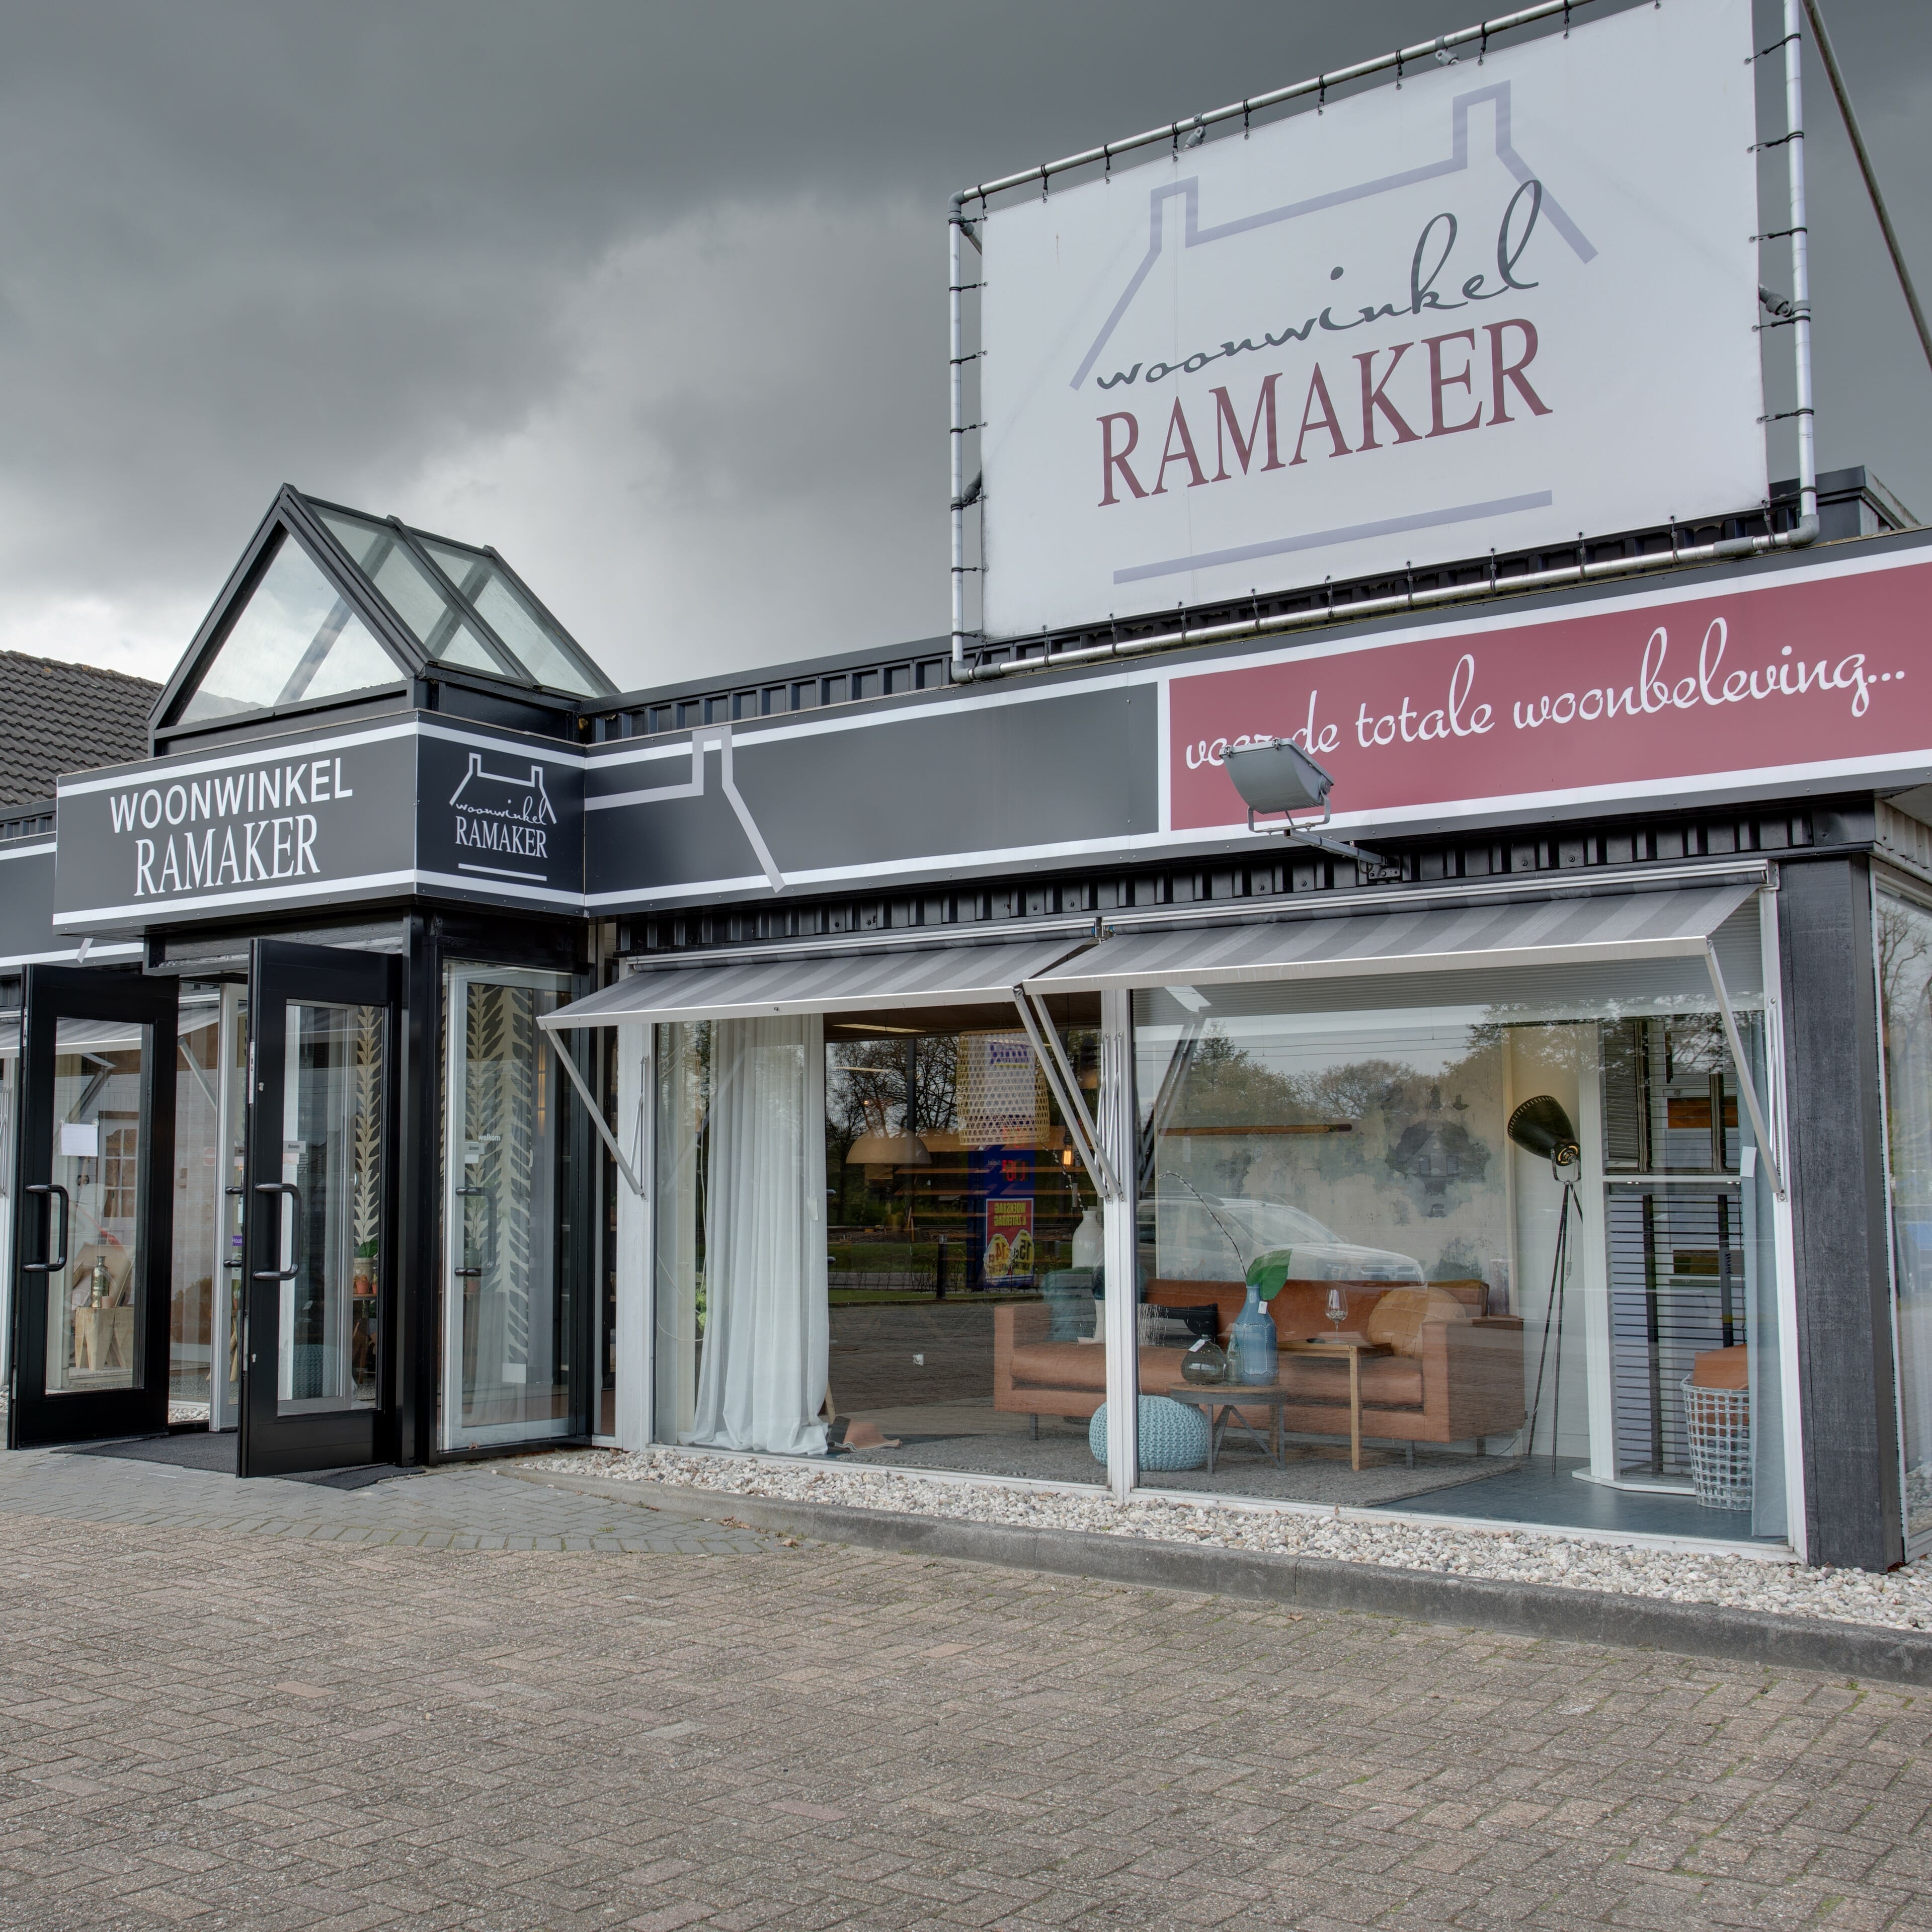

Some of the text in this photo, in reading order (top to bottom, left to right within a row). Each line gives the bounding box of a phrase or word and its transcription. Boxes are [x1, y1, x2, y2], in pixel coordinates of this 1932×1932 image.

[1096, 180, 1543, 390] woonwinkel
[1096, 317, 1553, 507] RAMAKER
[1292, 690, 1340, 755] de
[1355, 654, 1495, 748] totale
[110, 757, 353, 834] WOONWINKEL
[455, 796, 547, 826] woonwinkel
[134, 814, 320, 897] RAMAKER
[455, 816, 548, 859] RAMAKER
